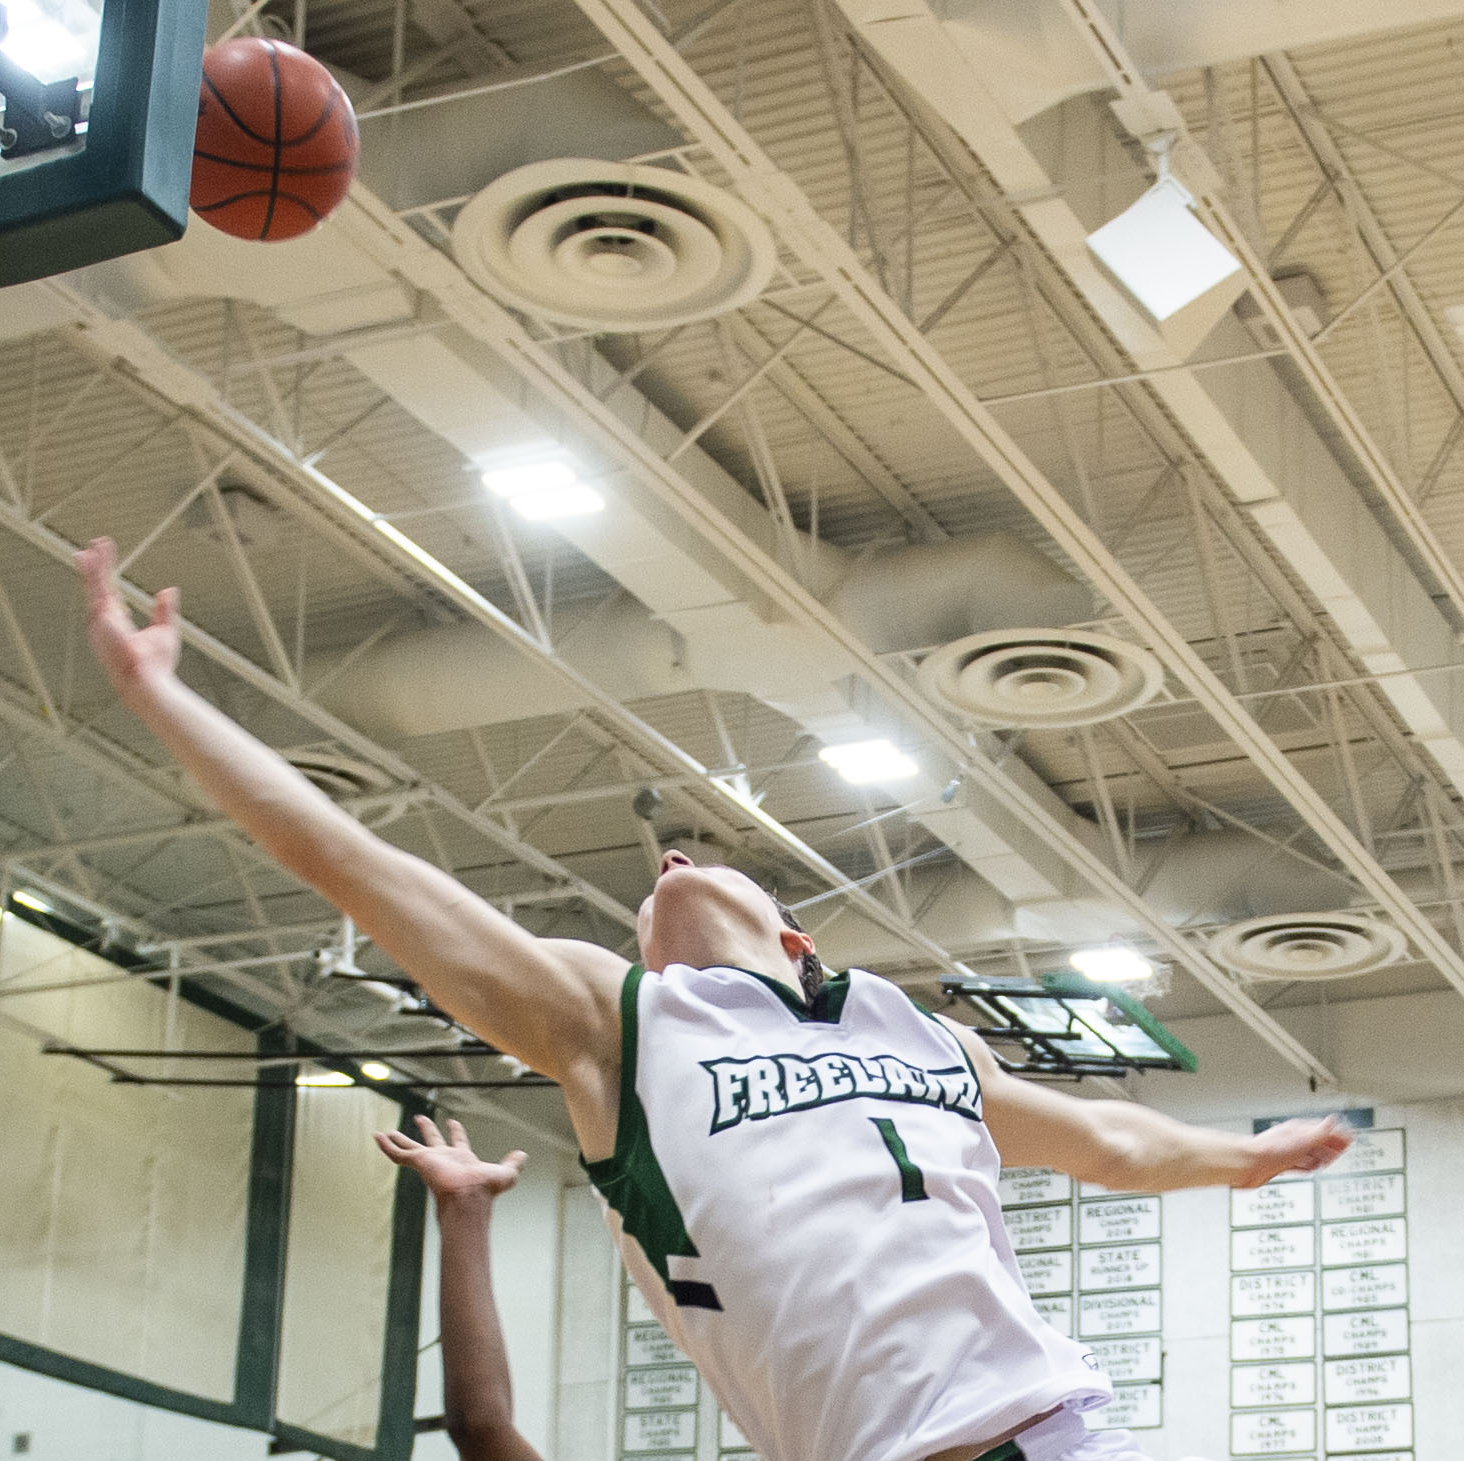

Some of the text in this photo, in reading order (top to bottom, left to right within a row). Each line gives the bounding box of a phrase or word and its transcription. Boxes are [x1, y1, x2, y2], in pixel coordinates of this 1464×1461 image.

[867, 1117, 930, 1203] 1
[1329, 1178, 1394, 1194] DISTRICT
[1087, 1203, 1152, 1217] REGIONAL
[1249, 1202, 1294, 1212] CHAMPS
[1100, 1217, 1138, 1227] CHAMPS
[1331, 1226, 1396, 1237] REGIONAL
[1340, 1239, 1386, 1248] CHAMPS
[1099, 1250, 1140, 1263] STATE
[1083, 1296, 1154, 1311] DIVISIONAL
[1100, 1311, 1139, 1320] CHAMPS
[1338, 1410, 1397, 1424] DISTRICT
